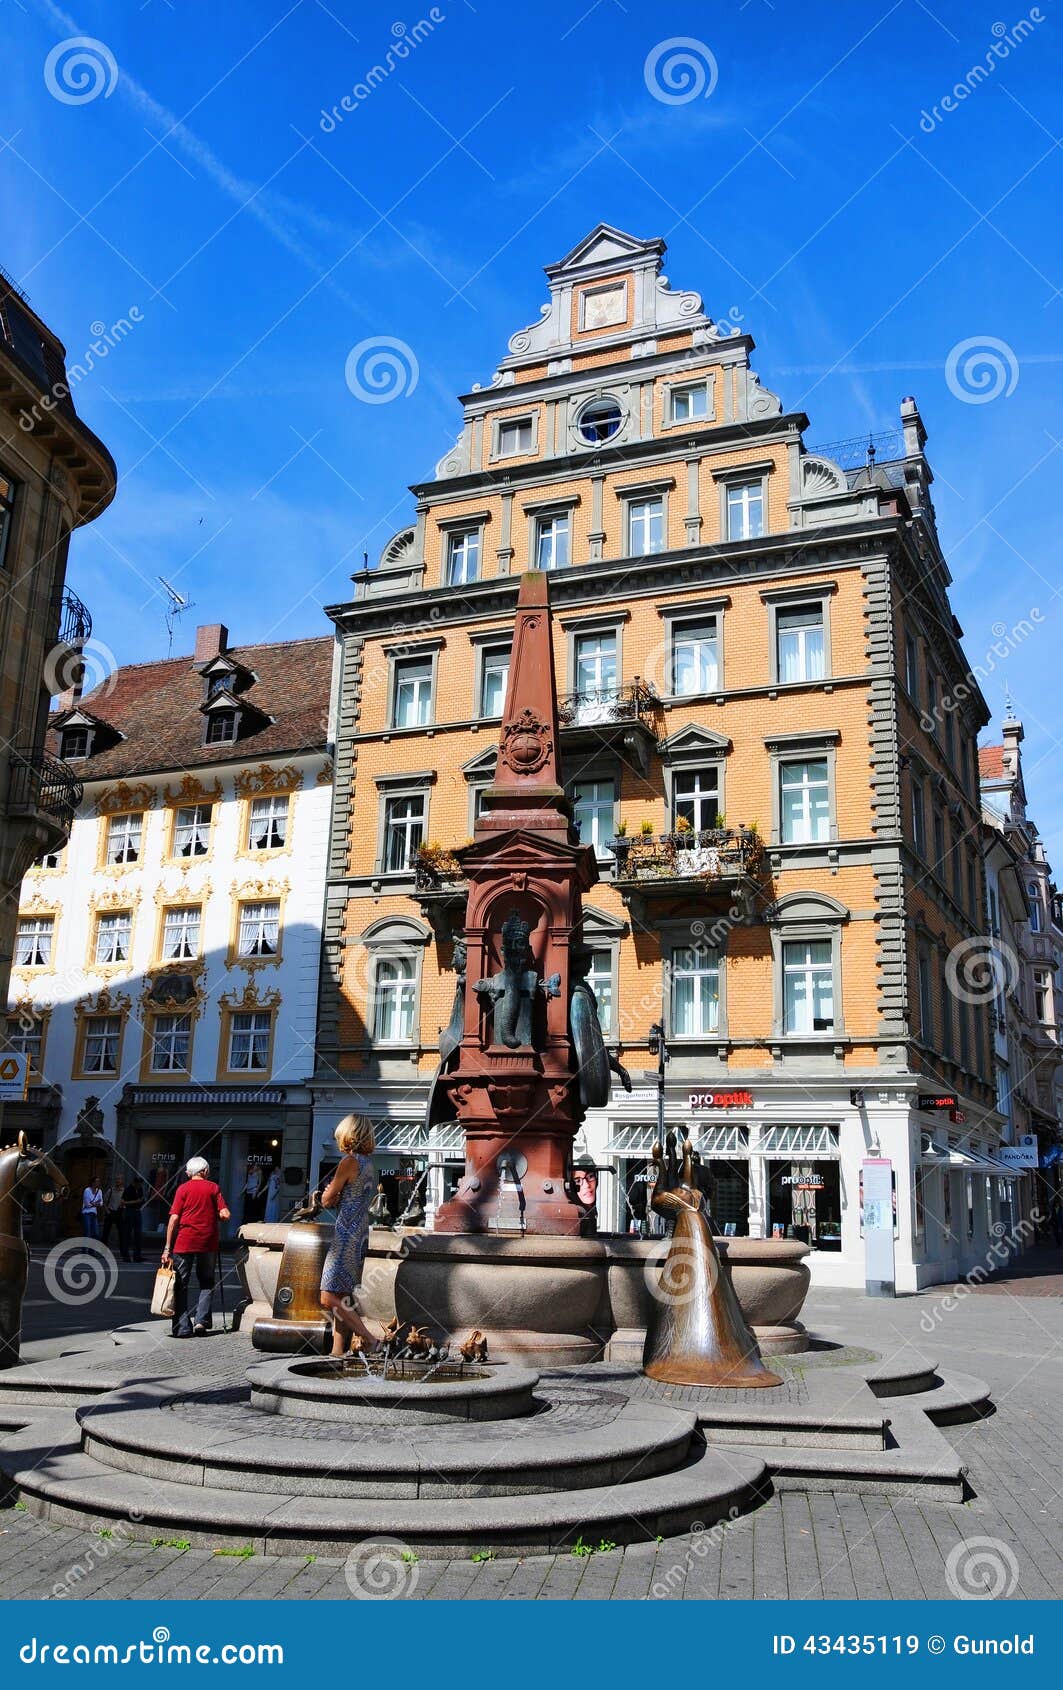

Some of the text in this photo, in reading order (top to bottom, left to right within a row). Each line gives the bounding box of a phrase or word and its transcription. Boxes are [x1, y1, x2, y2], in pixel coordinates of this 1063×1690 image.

[688, 1090, 753, 1107] prooptik
[921, 1097, 955, 1106] prooptik
[247, 1154, 273, 1162] chris
